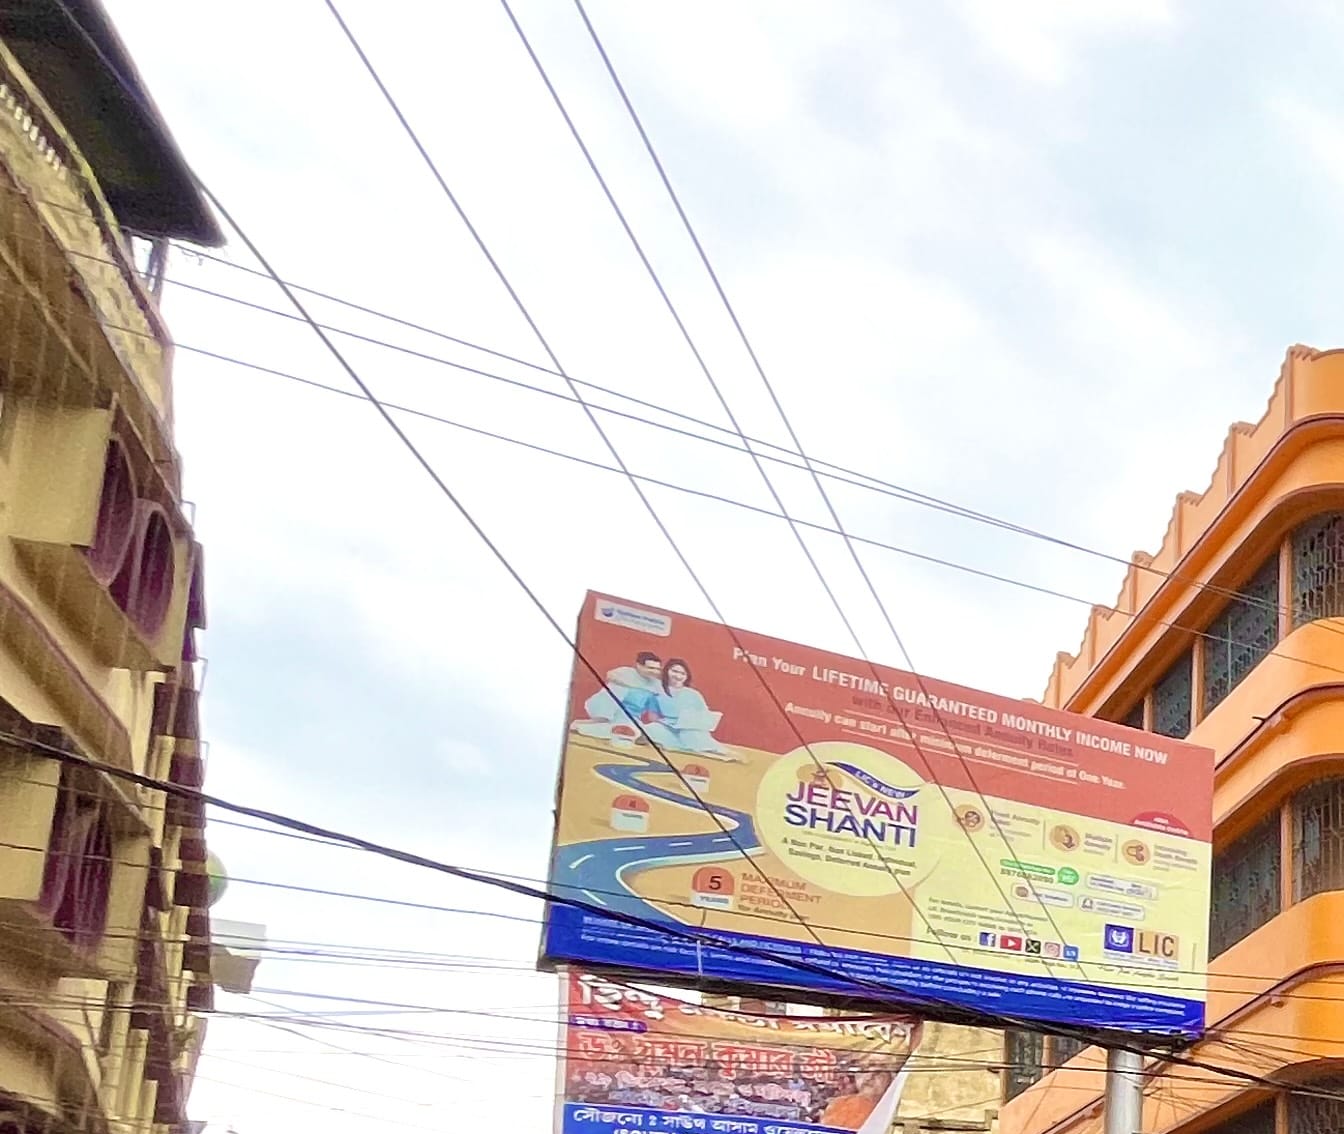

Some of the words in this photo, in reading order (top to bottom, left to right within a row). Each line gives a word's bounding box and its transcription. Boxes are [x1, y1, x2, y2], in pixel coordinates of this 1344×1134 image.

[733, 647, 768, 668] Plan
[772, 656, 806, 676] Your
[812, 665, 890, 697] LIFETIME
[893, 686, 998, 723] GUARANTEED
[1002, 714, 1072, 742] MONTHLY
[1076, 731, 1131, 757] INCOME
[1134, 744, 1168, 765] NOW
[785, 702, 832, 724] Annuity
[834, 714, 857, 727] can
[860, 720, 887, 735] start
[974, 746, 1029, 767] deferment
[1030, 758, 1064, 776] period
[1066, 767, 1078, 778] of
[1079, 769, 1100, 784] One
[786, 781, 918, 825] JEEVAN
[784, 803, 917, 848] SHANTI
[708, 876, 722, 891] 5
[740, 884, 823, 905] DEFERMENT
[1138, 932, 1176, 957] LIC
